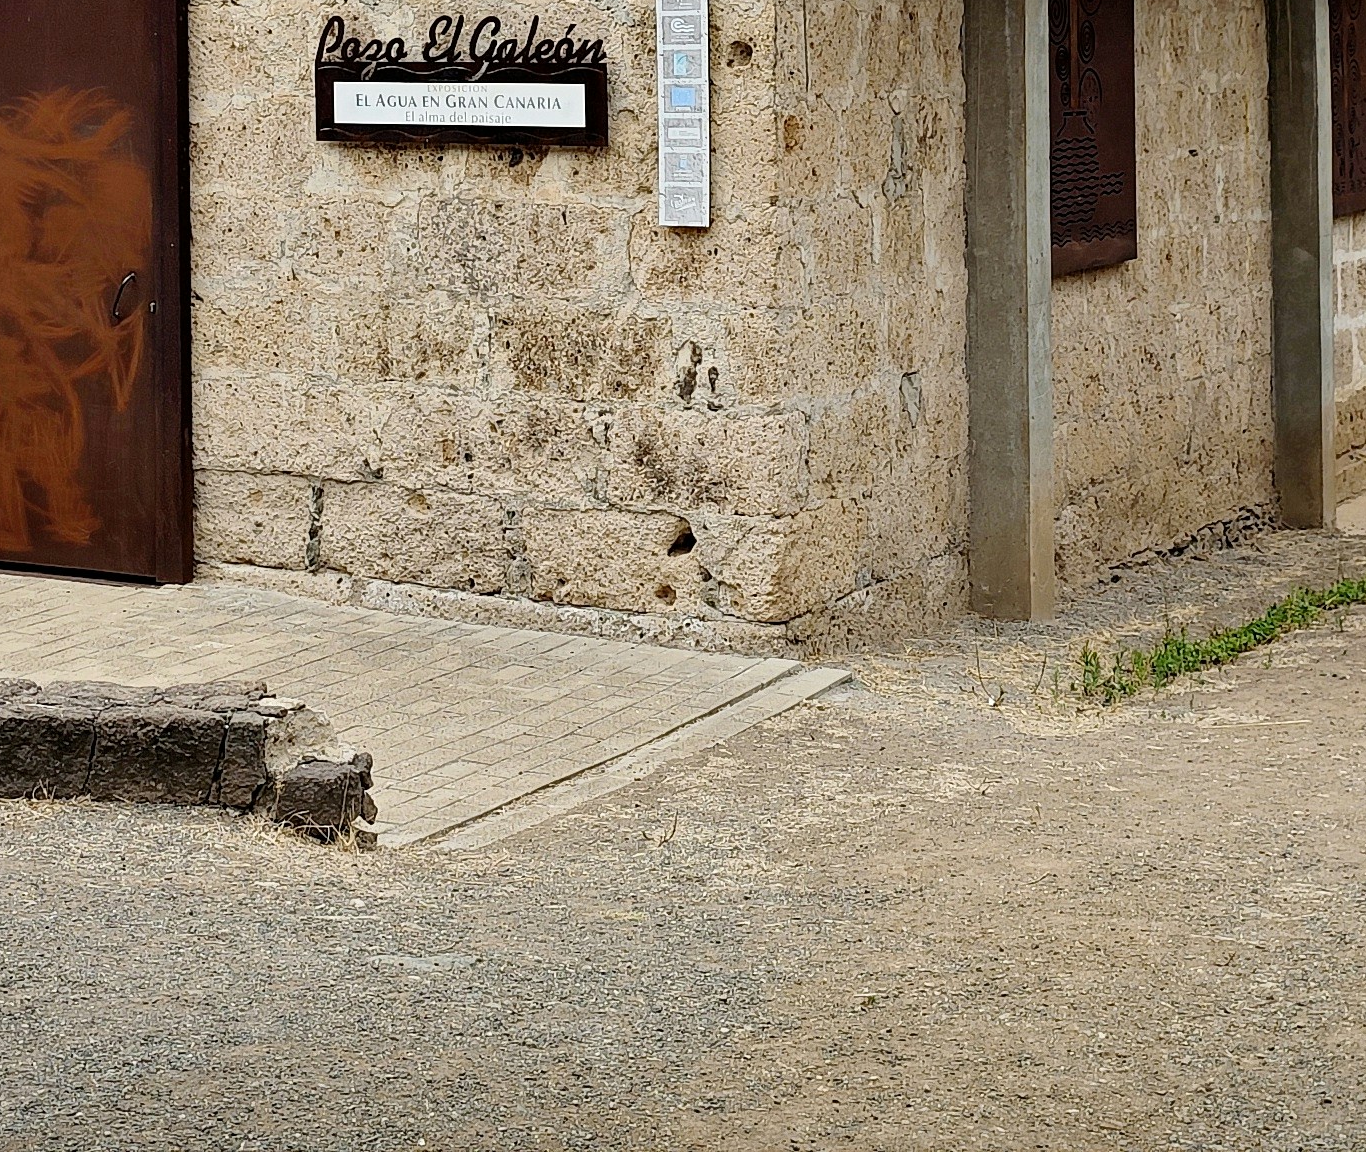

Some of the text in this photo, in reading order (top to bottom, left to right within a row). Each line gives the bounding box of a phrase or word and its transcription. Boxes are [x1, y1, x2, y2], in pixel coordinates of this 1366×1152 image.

[315, 14, 608, 80] Pozo El Galeón
[405, 111, 512, 125] El alma del paisaje
